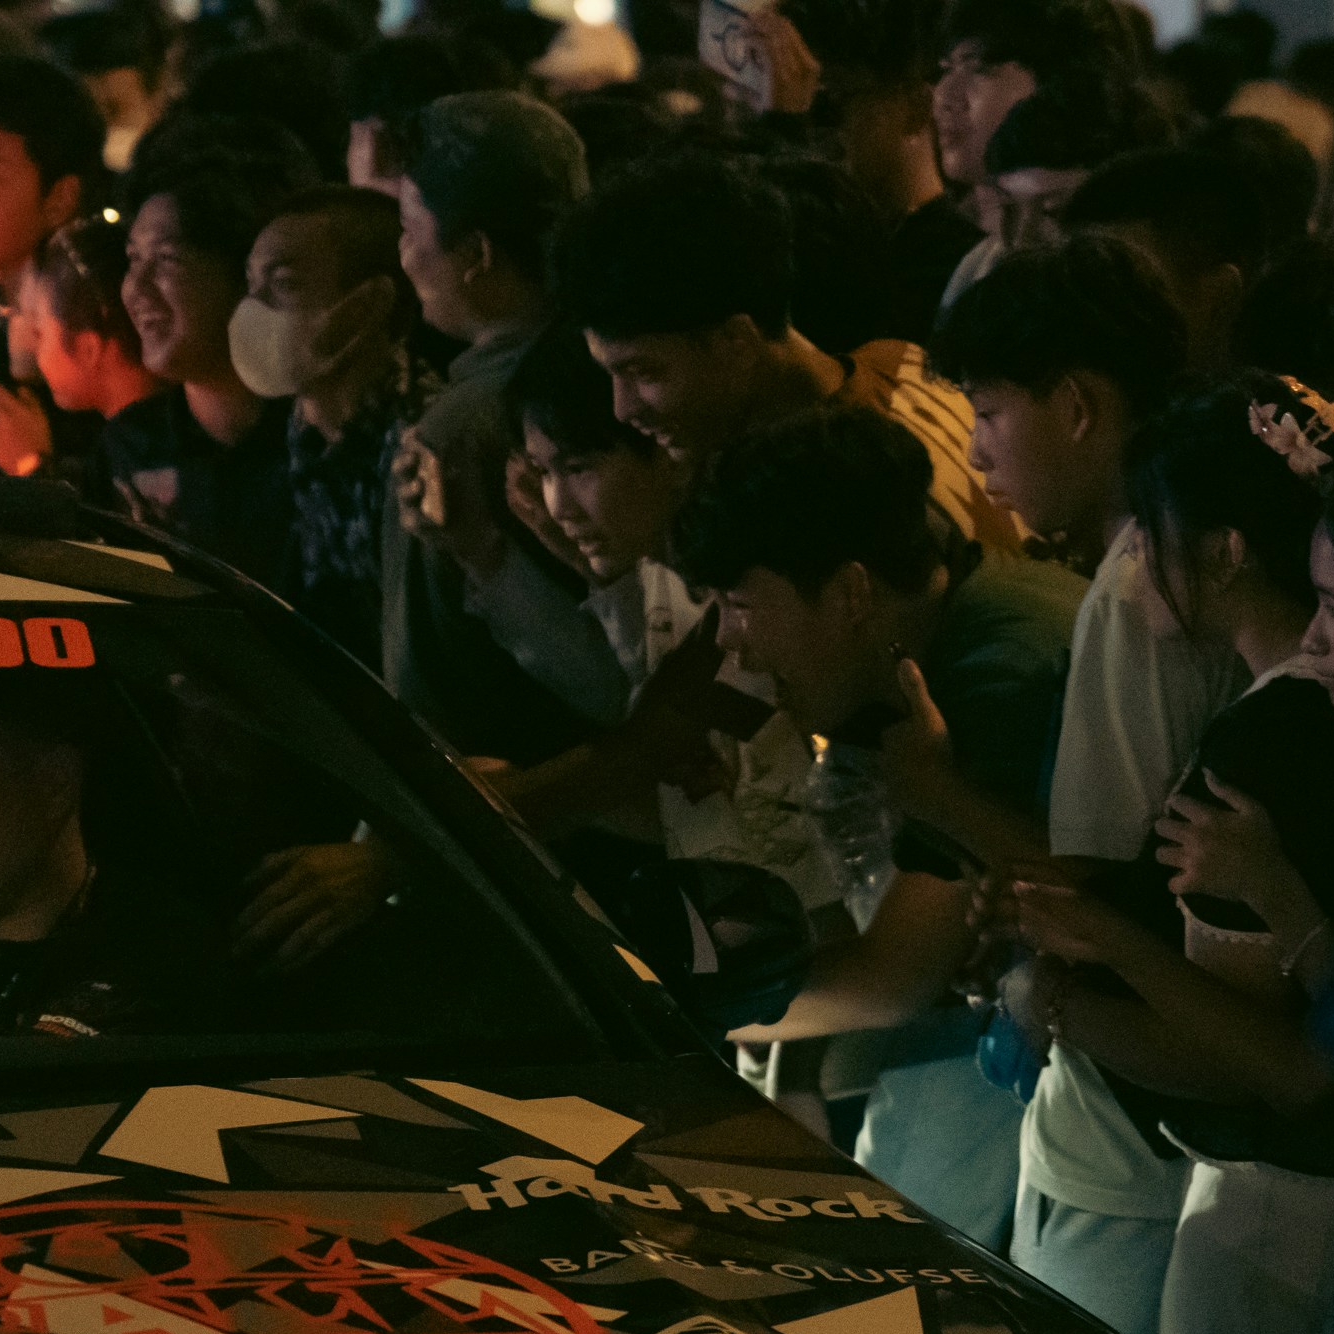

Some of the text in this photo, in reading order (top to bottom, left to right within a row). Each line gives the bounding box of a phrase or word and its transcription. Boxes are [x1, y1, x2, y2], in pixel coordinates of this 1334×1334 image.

[448, 1173, 924, 1223] Hard Rock
[539, 1236, 705, 1274] BANG
